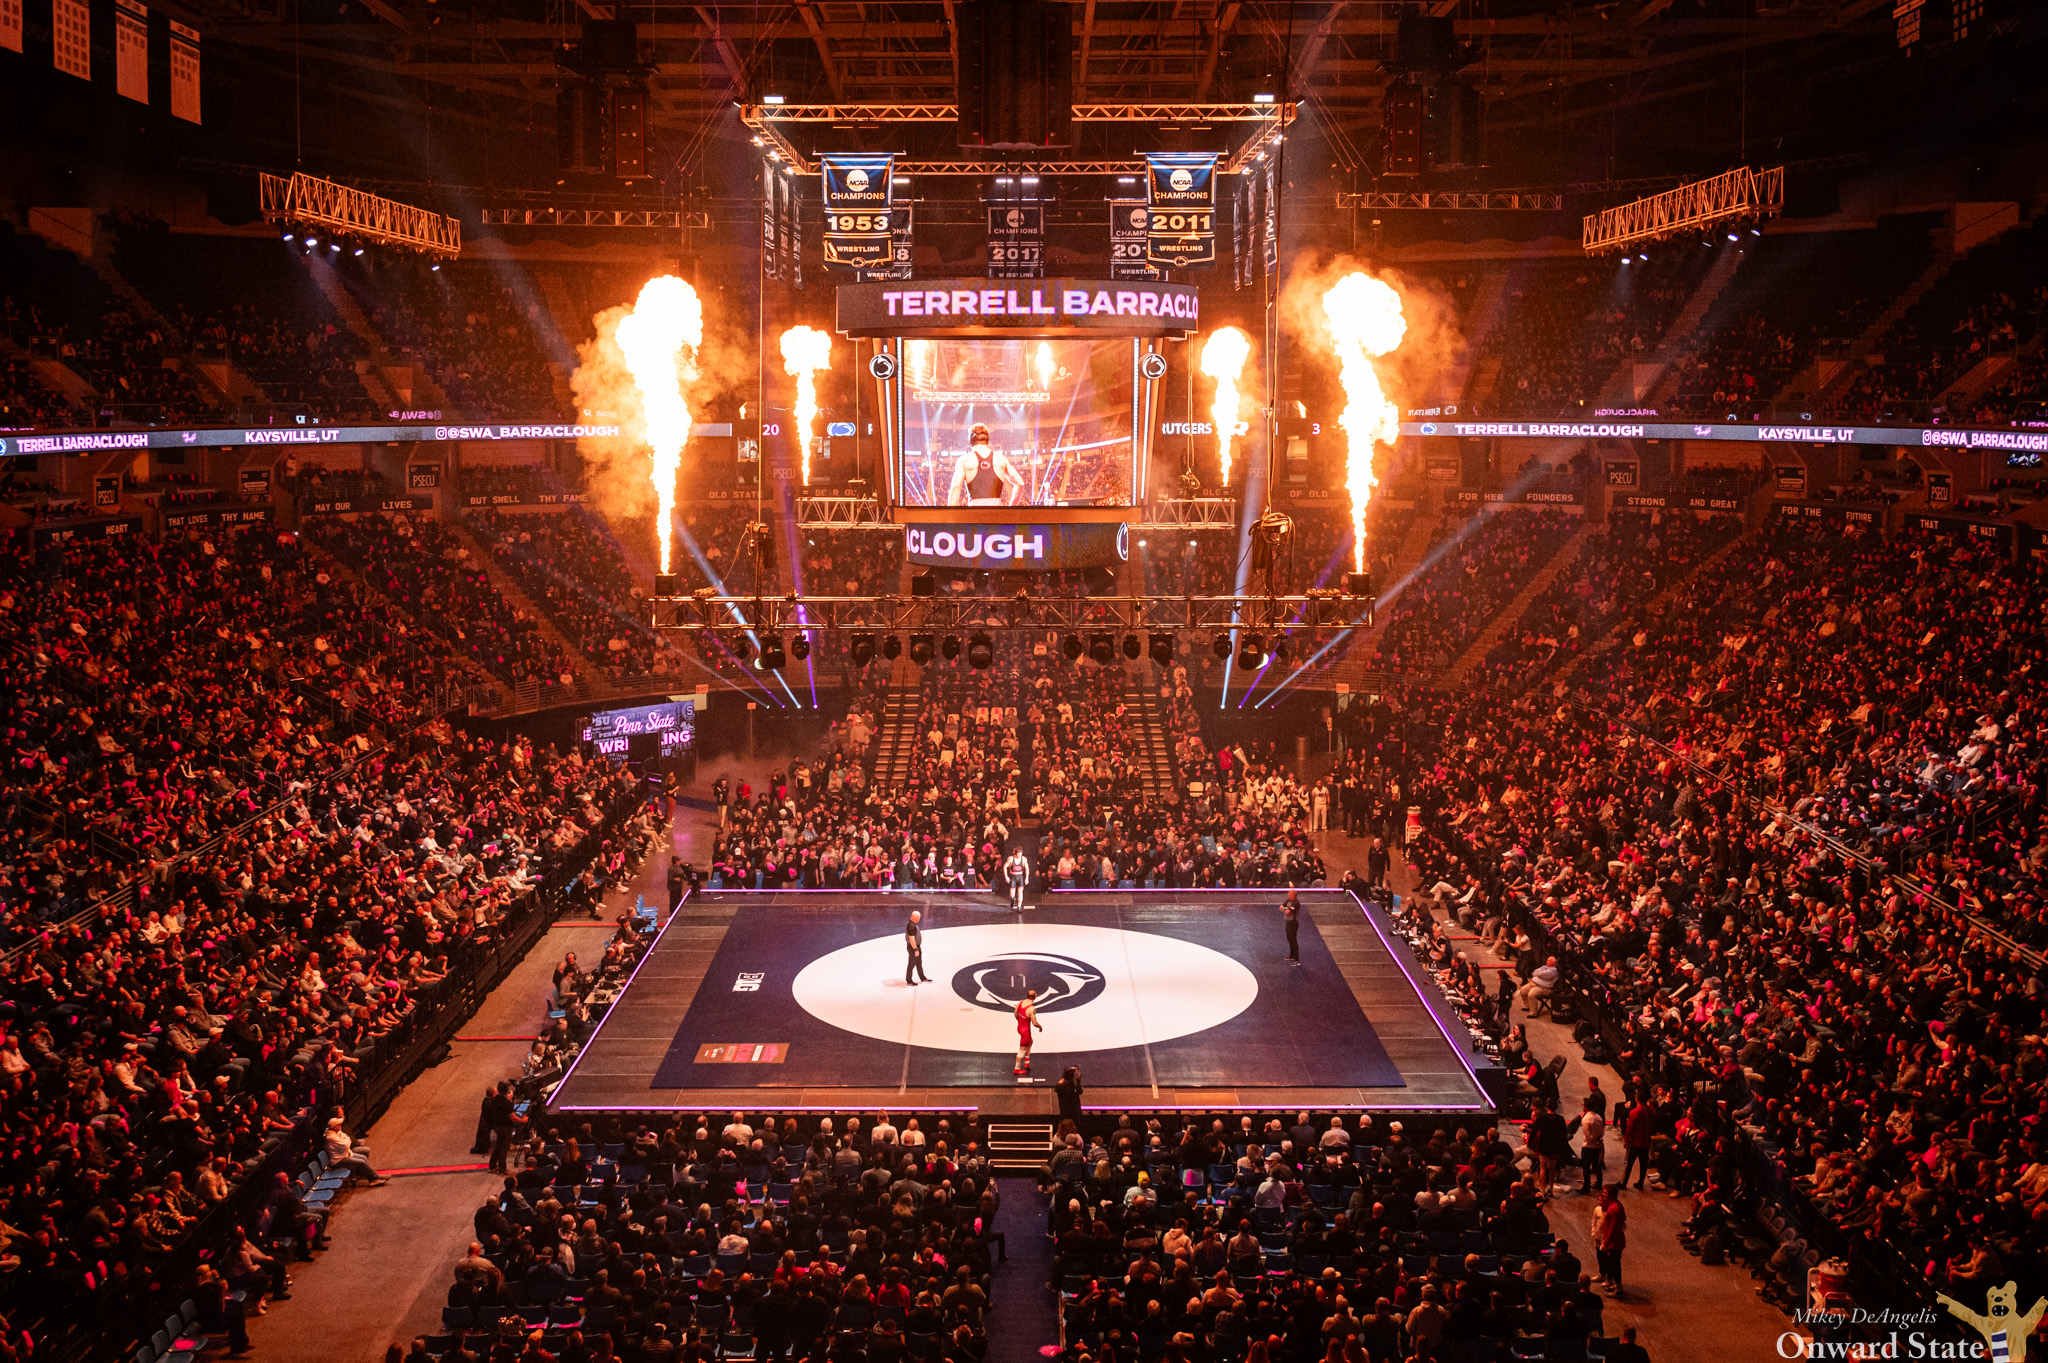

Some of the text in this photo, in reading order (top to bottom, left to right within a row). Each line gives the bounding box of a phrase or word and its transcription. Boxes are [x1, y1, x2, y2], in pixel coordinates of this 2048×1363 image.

[830, 192, 885, 200] CHAMPIONS
[827, 216, 889, 230] 1953
[1152, 215, 1210, 229] 2011
[992, 248, 1039, 260] 2017
[883, 290, 1055, 317] TERRELL
[447, 426, 619, 439] @SWA_BARRACLOUGH
[762, 424, 779, 436] 20
[1312, 423, 1320, 434] 3
[1454, 425, 1643, 437] TERRELL BARRACLOUGH
[245, 430, 339, 443] KAYSVILLE, UT
[1758, 428, 1854, 443] KAYSVILLE, UT
[1931, 430, 2048, 450] @SWA_BARRACLOUGH
[17, 434, 148, 453] TERRELL BARRACLOUGH
[774, 468, 795, 479] PSECU
[1248, 468, 1268, 478] PSEC
[1610, 472, 1632, 484] PSECU
[413, 475, 435, 487] PSECU
[98, 489, 115, 504] PSECU
[709, 491, 763, 499] OLD STATE
[815, 489, 839, 497] DER
[1289, 490, 1303, 498] OF
[1308, 490, 1328, 498] OLD
[1458, 492, 1574, 502] FOR HER FOUNDERS
[470, 494, 588, 505] BUT SWELL THY FAME
[1627, 497, 1737, 509] STRONG AND GREAT
[315, 501, 412, 512] MAY OUR LIVES
[1782, 506, 1798, 516] FOR
[1805, 507, 1821, 517] THE
[168, 511, 265, 526] THAT LOVES THY NAME
[1920, 519, 1939, 530] THAT
[105, 524, 128, 534] HEART
[907, 533, 1043, 559] CLOUGH
[612, 711, 676, 736] Penn State
